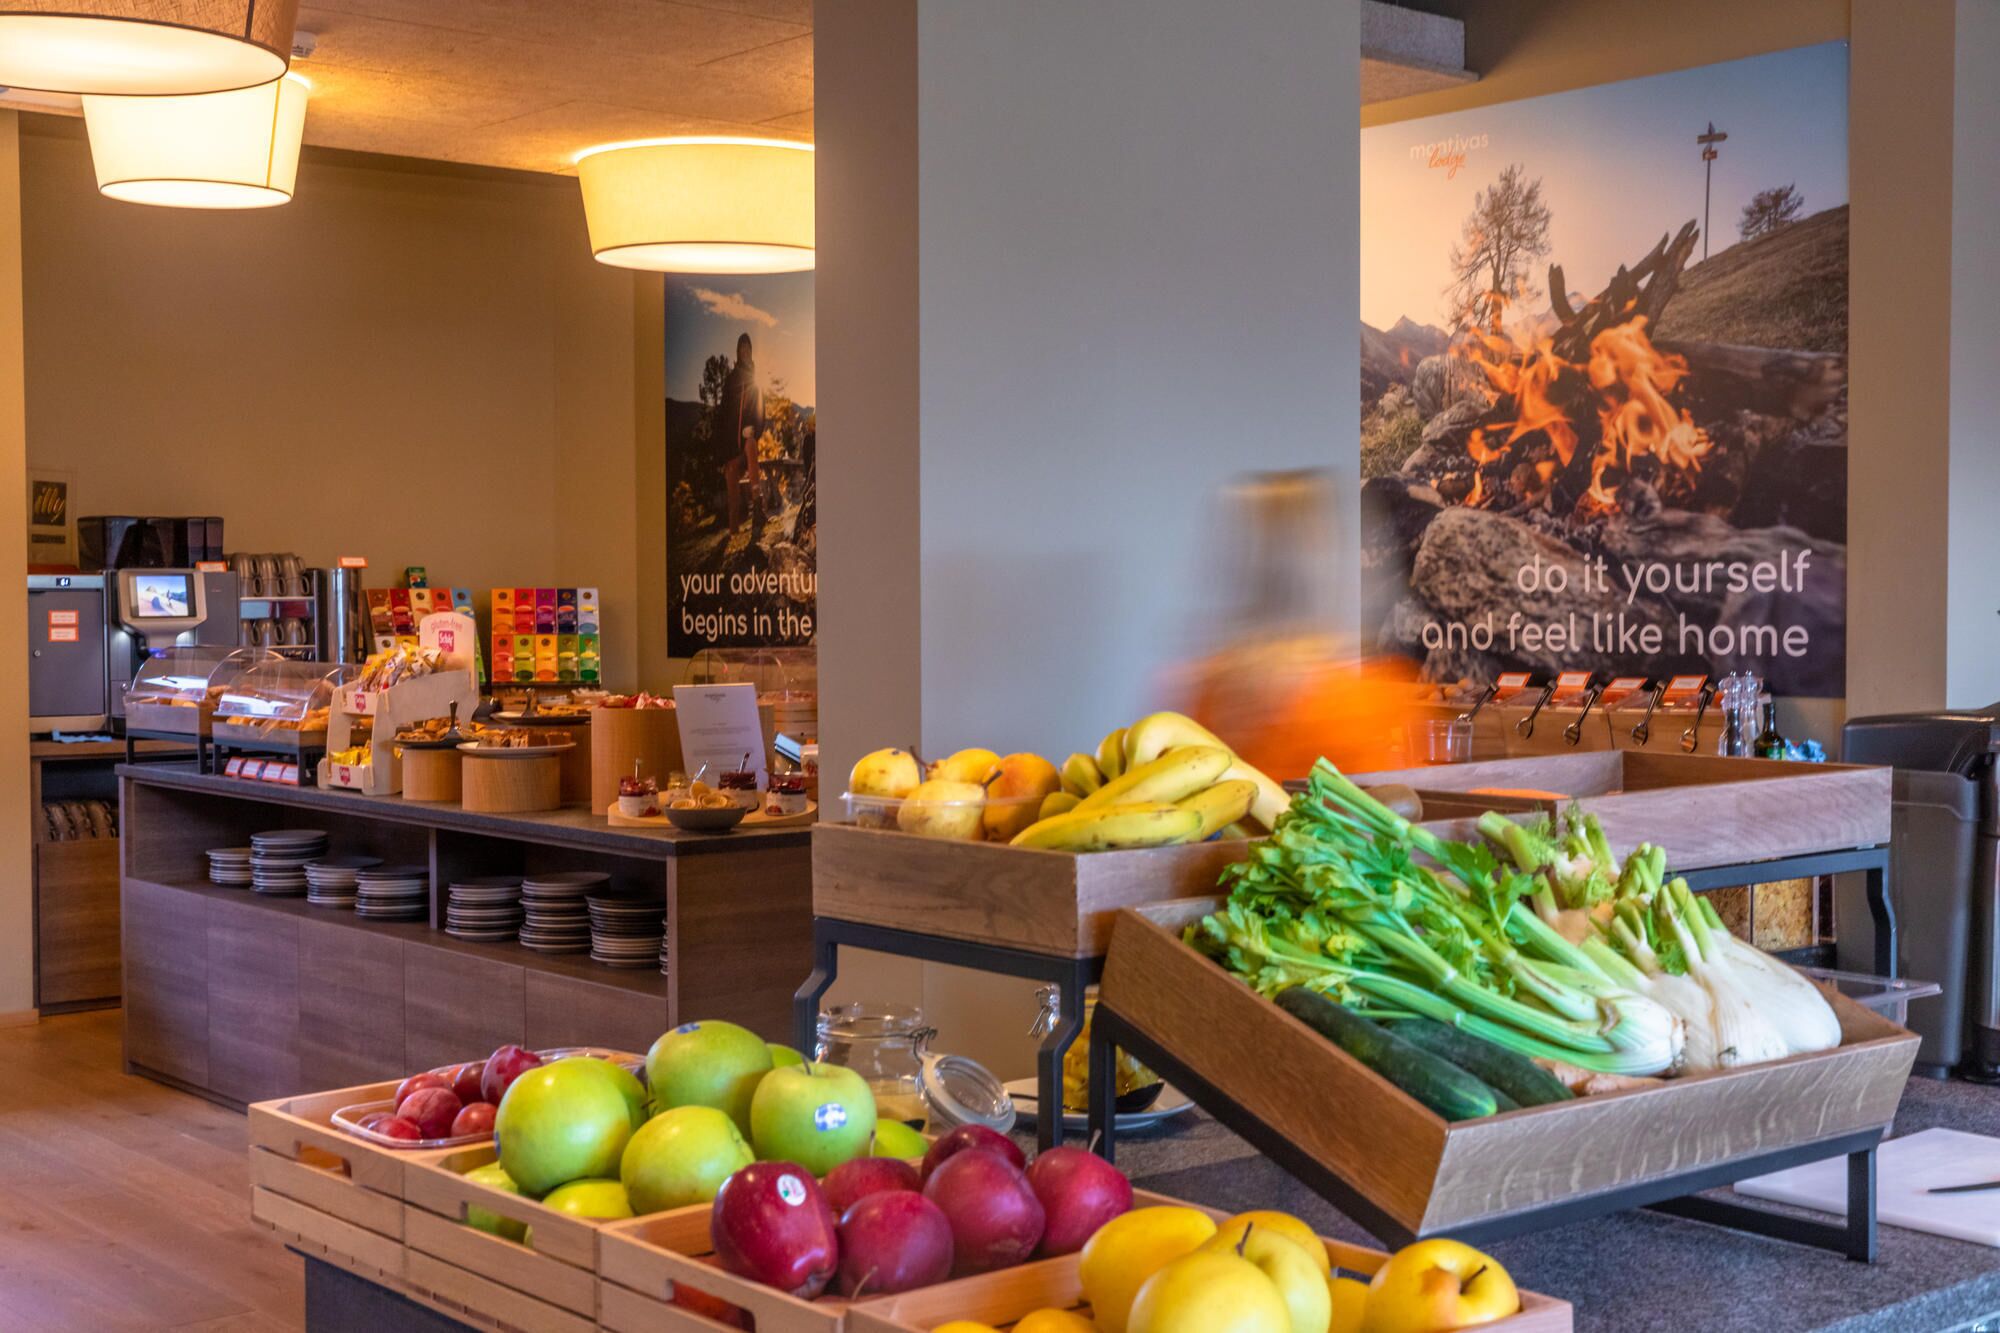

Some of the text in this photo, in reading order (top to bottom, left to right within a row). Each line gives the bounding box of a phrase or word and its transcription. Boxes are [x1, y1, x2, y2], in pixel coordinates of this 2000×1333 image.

[1410, 132, 1489, 160] montivas
[1428, 145, 1467, 180] lodge
[35, 487, 65, 523] illy
[680, 573, 725, 603] your
[1517, 548, 1813, 604] do it yourself
[681, 606, 812, 643] begins in the
[1421, 612, 1810, 657] and feel like home
